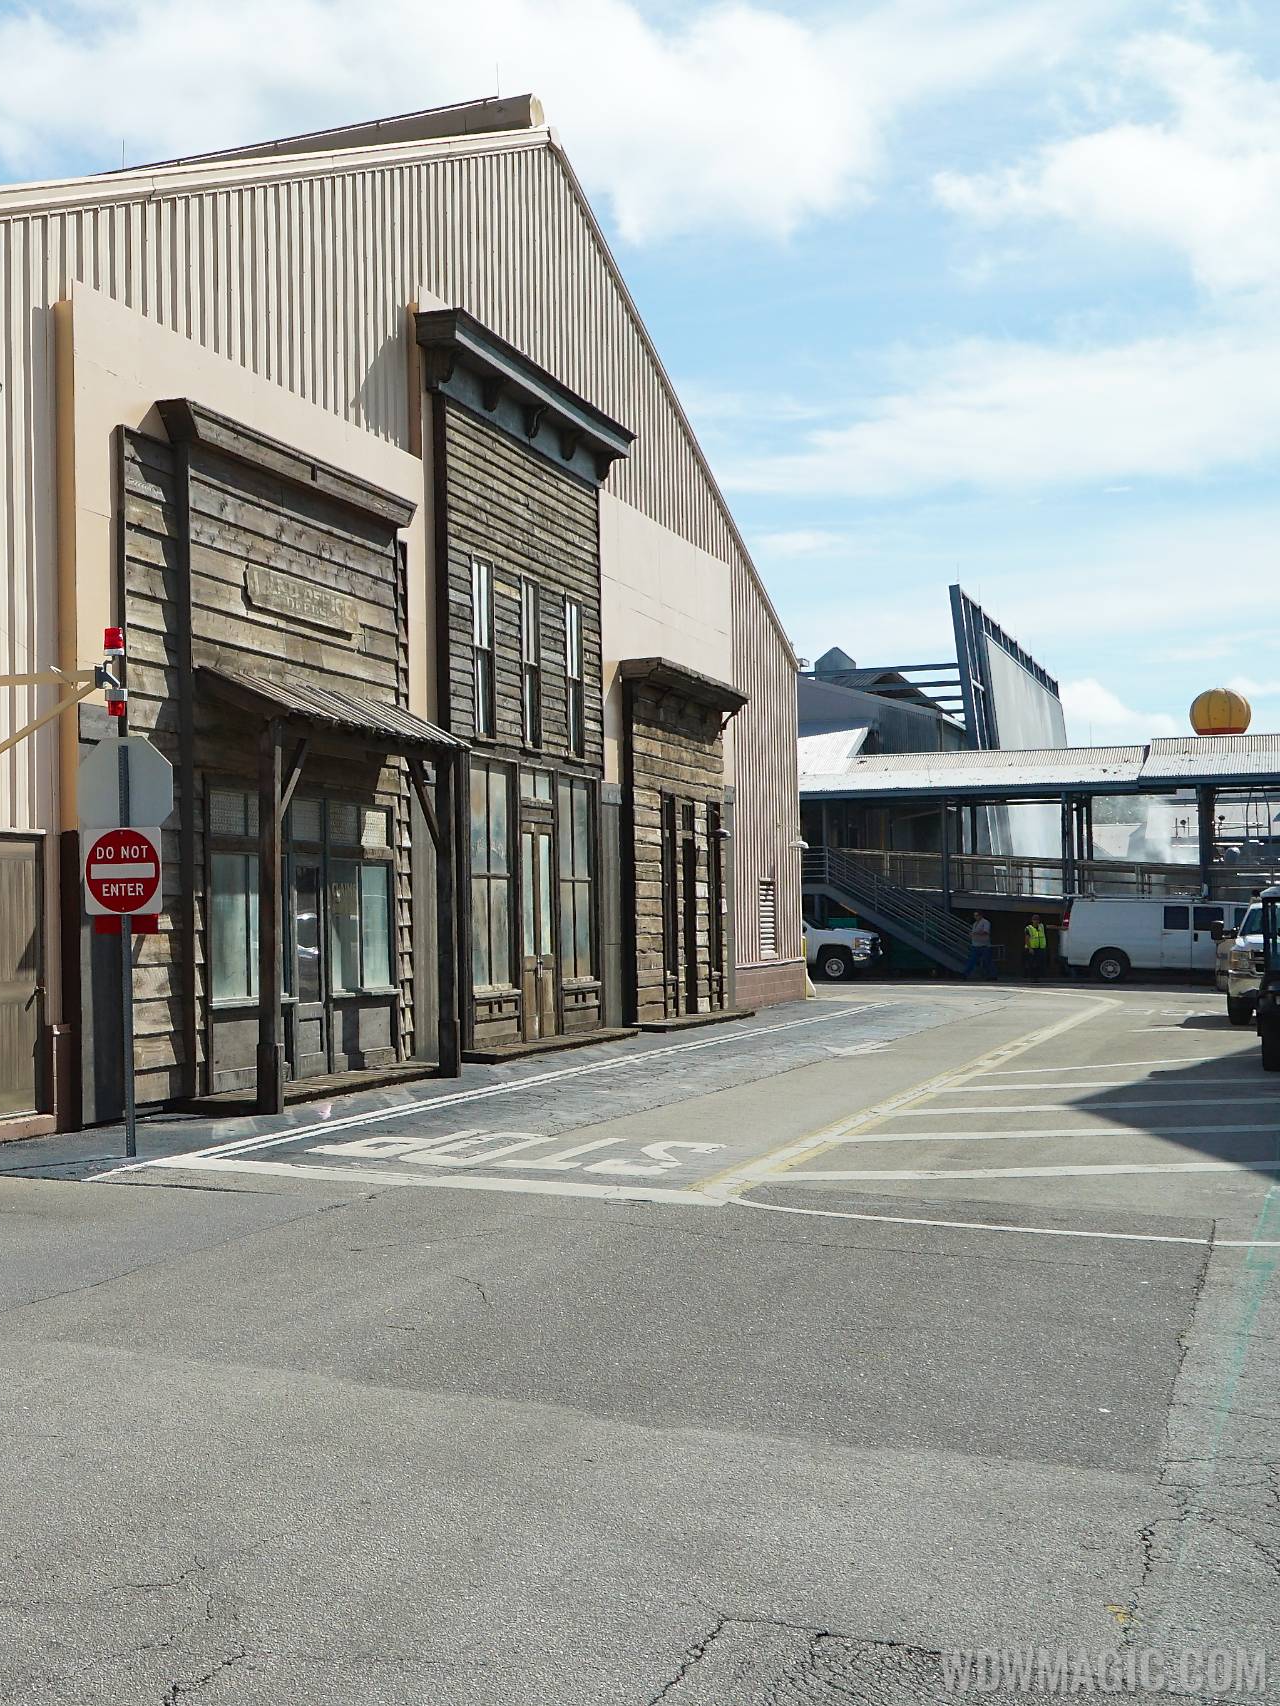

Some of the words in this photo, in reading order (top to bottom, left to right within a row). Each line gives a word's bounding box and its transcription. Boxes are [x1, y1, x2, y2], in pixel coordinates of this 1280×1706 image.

[96, 846, 115, 860] DO
[120, 845, 148, 859] NOT
[101, 883, 145, 897] ENTER
[304, 1129, 728, 1176] STOP
